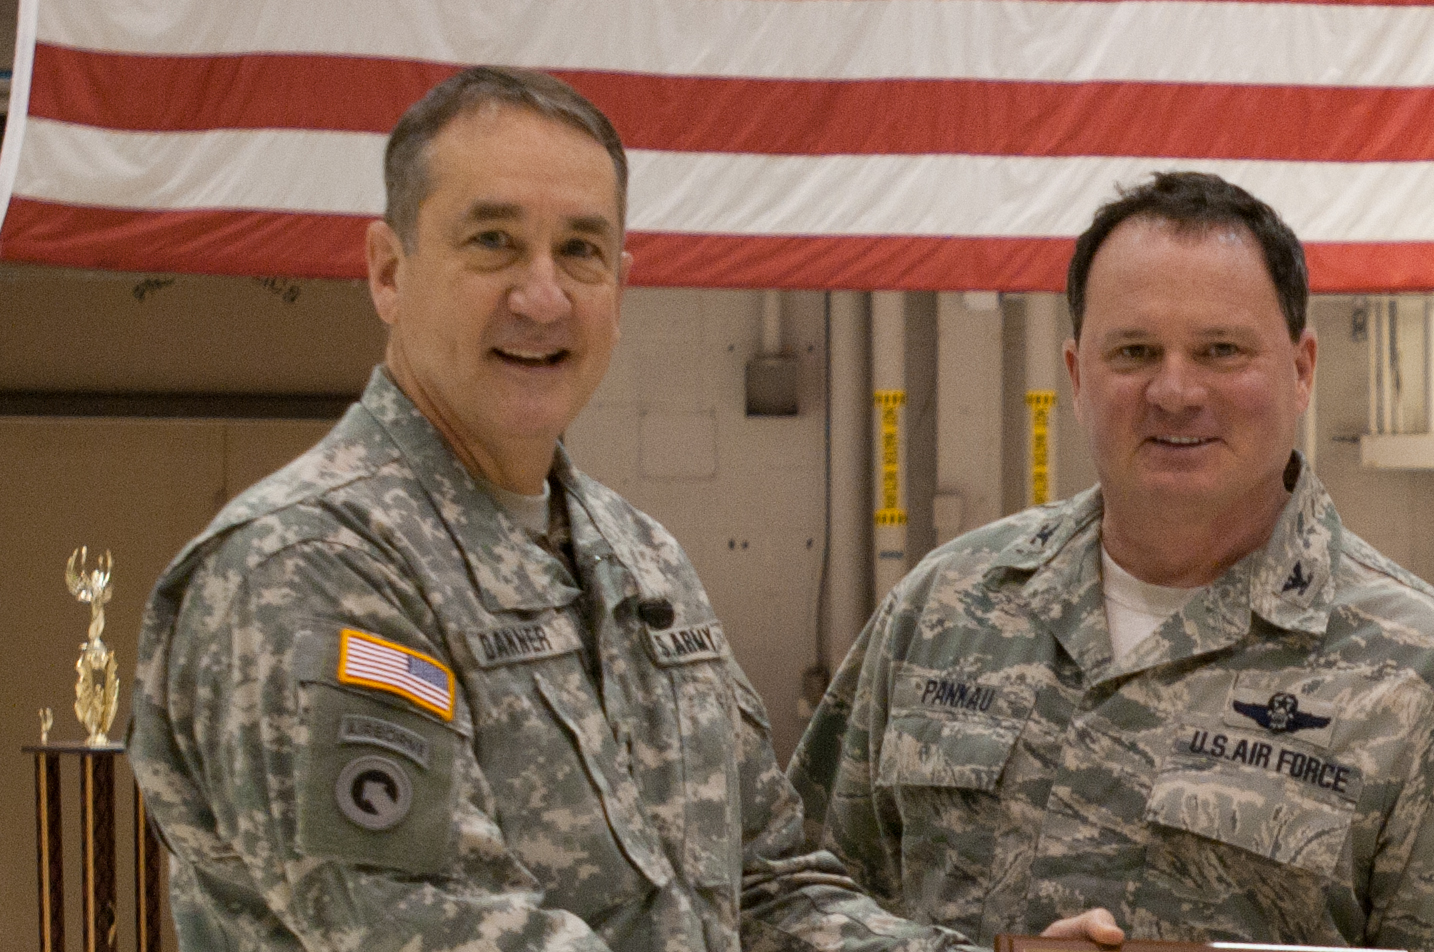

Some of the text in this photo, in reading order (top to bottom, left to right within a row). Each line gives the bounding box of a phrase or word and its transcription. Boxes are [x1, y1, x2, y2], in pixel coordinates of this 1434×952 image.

[479, 624, 554, 661] DANNER
[920, 680, 996, 712] PANKAU
[1275, 748, 1350, 794] FORCE
